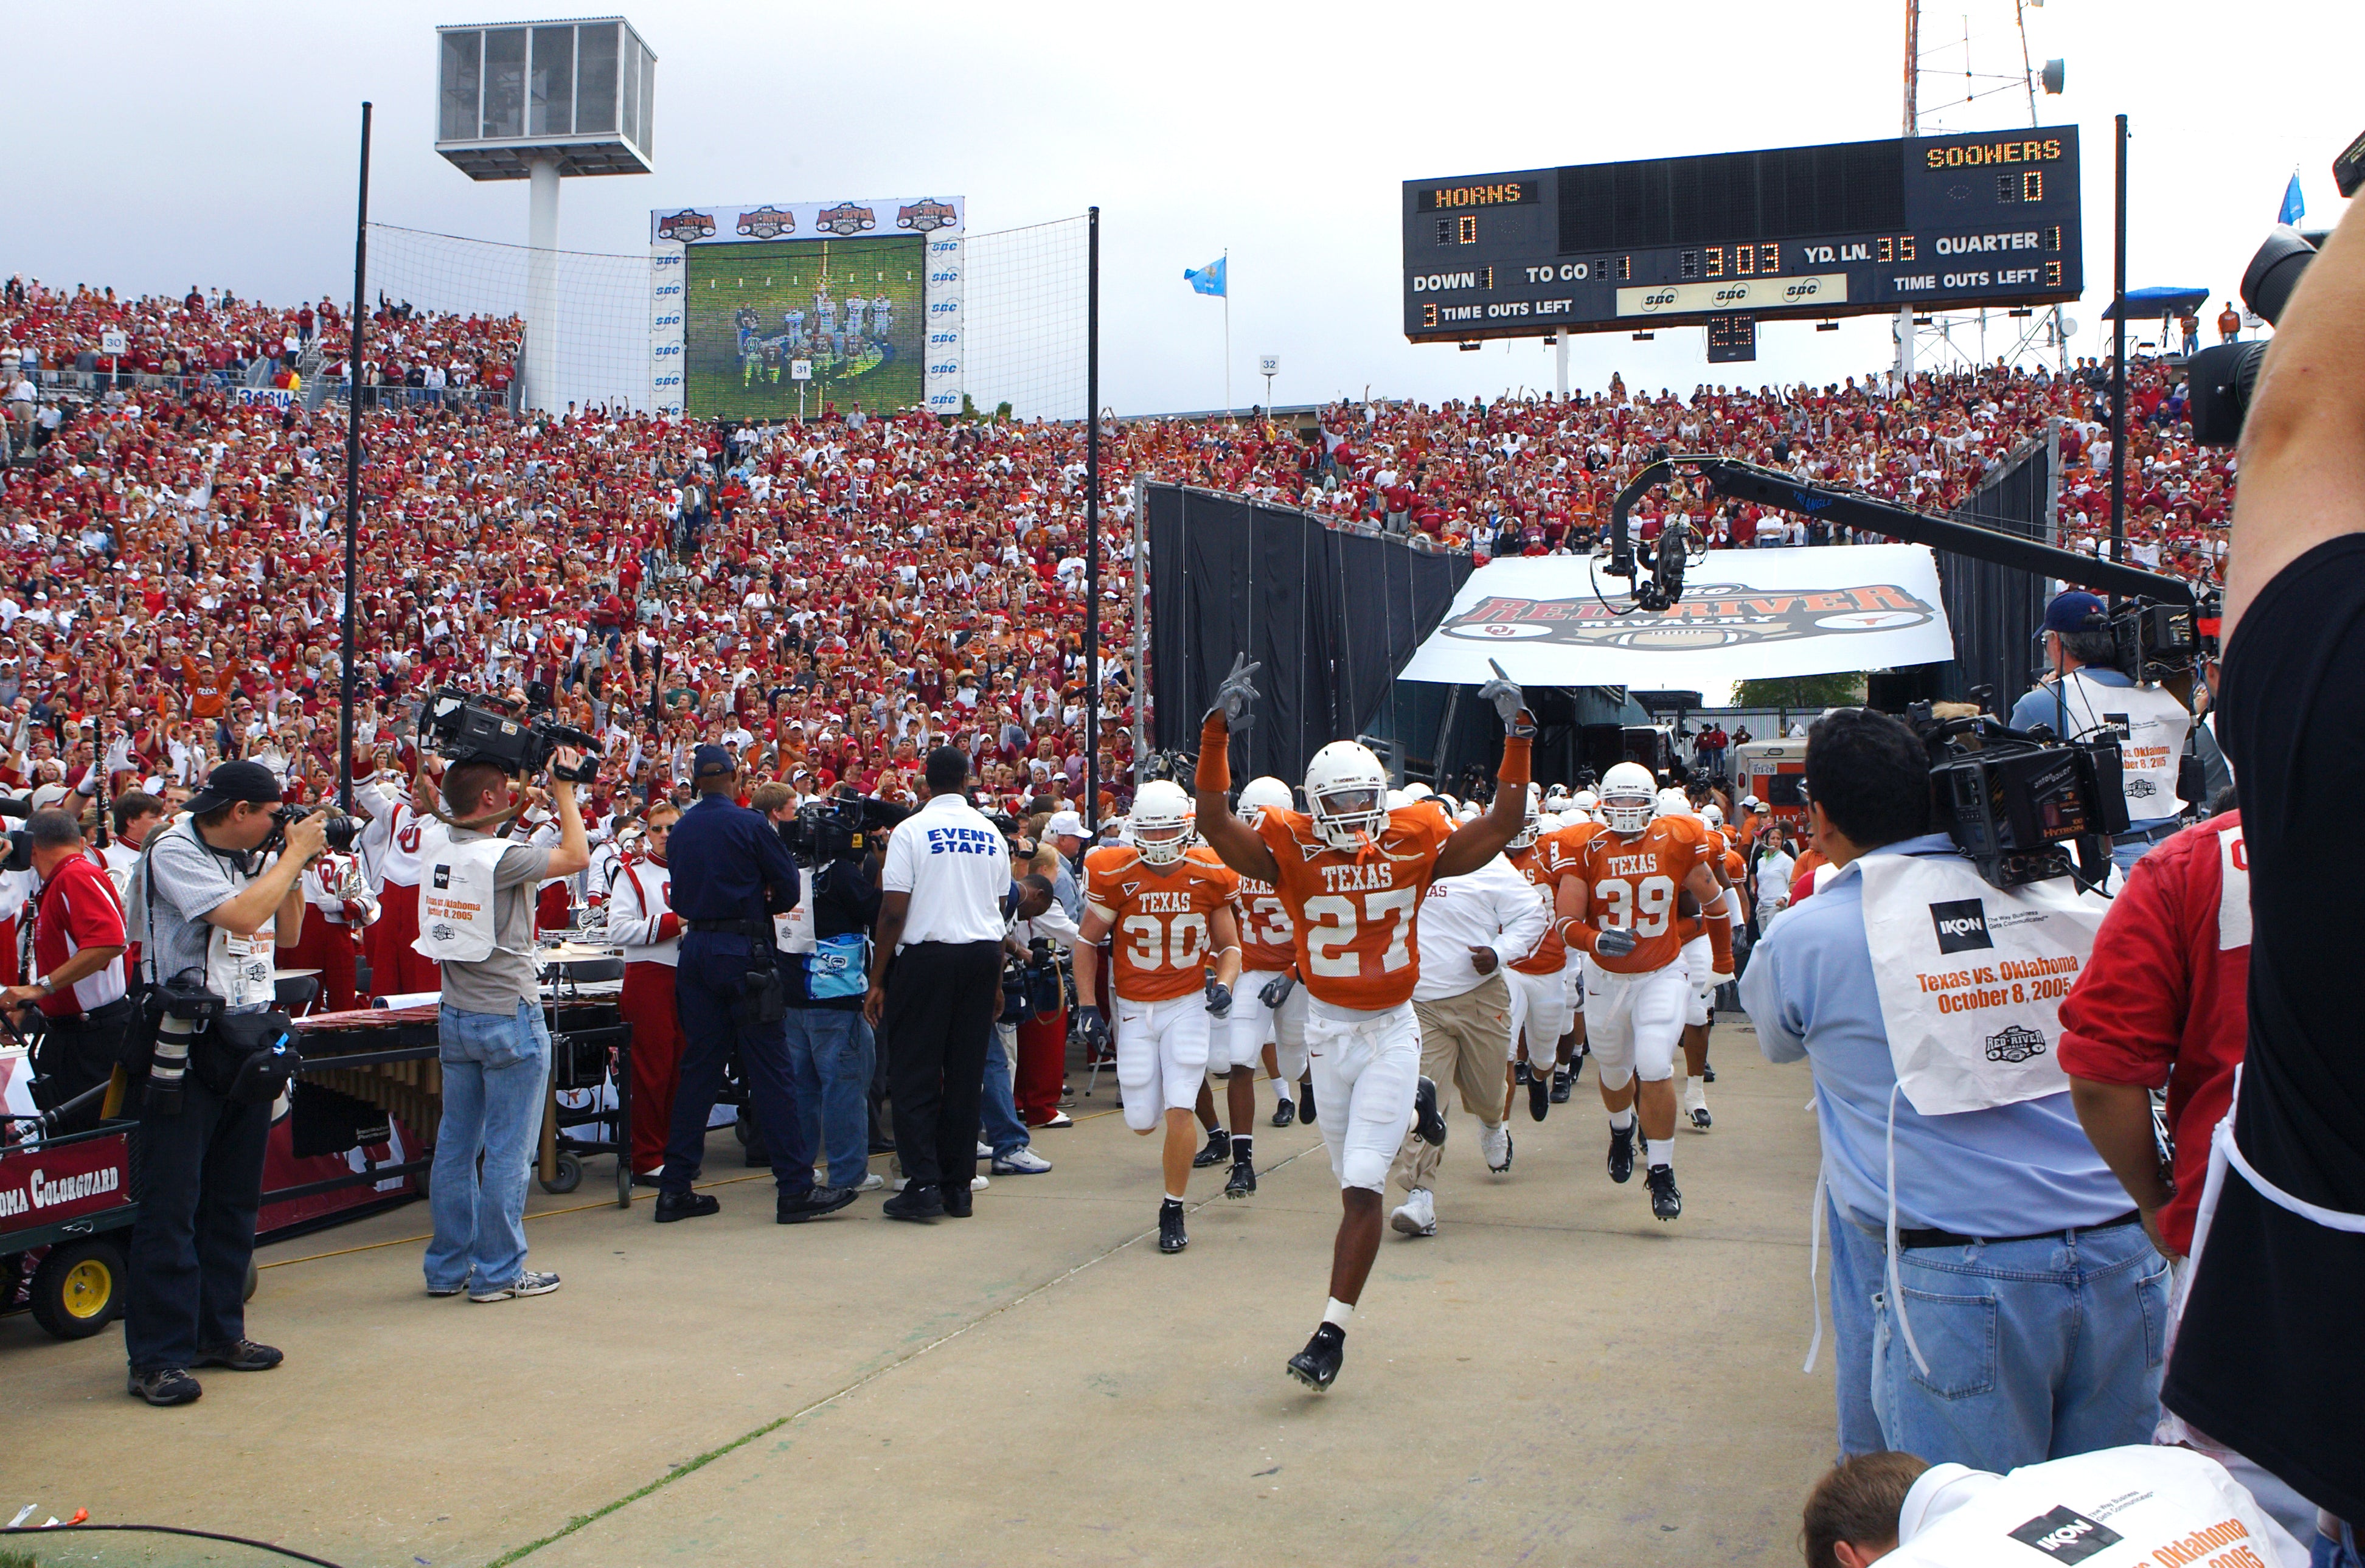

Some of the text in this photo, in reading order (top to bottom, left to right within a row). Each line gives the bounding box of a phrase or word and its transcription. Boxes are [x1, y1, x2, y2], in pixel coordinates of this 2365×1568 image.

[1436, 184, 1520, 207] HORNS
[932, 243, 957, 251] SBC
[1936, 232, 2038, 255] QUARTER
[656, 256, 681, 265] SBC
[1804, 244, 1872, 264] YD. LN.
[932, 273, 957, 282] SBC
[1414, 272, 1475, 292] DOWN
[1526, 263, 1588, 283] TO GO
[1894, 269, 2039, 291] TIME OUTS LEFT
[656, 286, 680, 295] SBC
[1644, 285, 1818, 305] SBC SBC SBC
[931, 304, 957, 312] SBC
[1442, 299, 1572, 321] TIME OUTS LEFT
[655, 316, 680, 325] SBC
[931, 335, 957, 343] SBC
[1710, 316, 1751, 347] 25
[106, 338, 122, 347] 30
[655, 347, 680, 356] SBC
[796, 366, 807, 374] 31
[931, 365, 957, 373] SBC
[1263, 360, 1276, 369] 32
[655, 377, 679, 386] SBC
[930, 395, 957, 404] SBC
[1793, 490, 1833, 511] TRIANGLE
[1459, 586, 1919, 622] RED RIVER
[1579, 616, 1777, 628] RIVALRY
[927, 828, 995, 844] EVENT
[931, 841, 997, 856] STAFF
[1608, 853, 1658, 876] TEXAS
[1241, 876, 1276, 894] EXAS
[1321, 862, 1393, 893] TEXAS
[1139, 892, 1191, 913] TEXAS
[1595, 875, 1675, 938] 39
[451, 910, 473, 921] 2005
[1234, 897, 1294, 945] 13
[1304, 884, 1417, 977] 27
[1939, 917, 1983, 937] IKON
[1122, 912, 1207, 971] 30
[1916, 955, 2080, 993] Texas vs. Oklahoma
[1937, 977, 2072, 1015] October 8, 2005
[1987, 1030, 2044, 1052] RED RIVER
[2087, 1508, 2102, 1518] The
[2111, 1491, 2139, 1504] Business
[2096, 1511, 2112, 1522] Gets
[2037, 1518, 2094, 1552] IKON
[2151, 1518, 2249, 1568] Oklahoma
